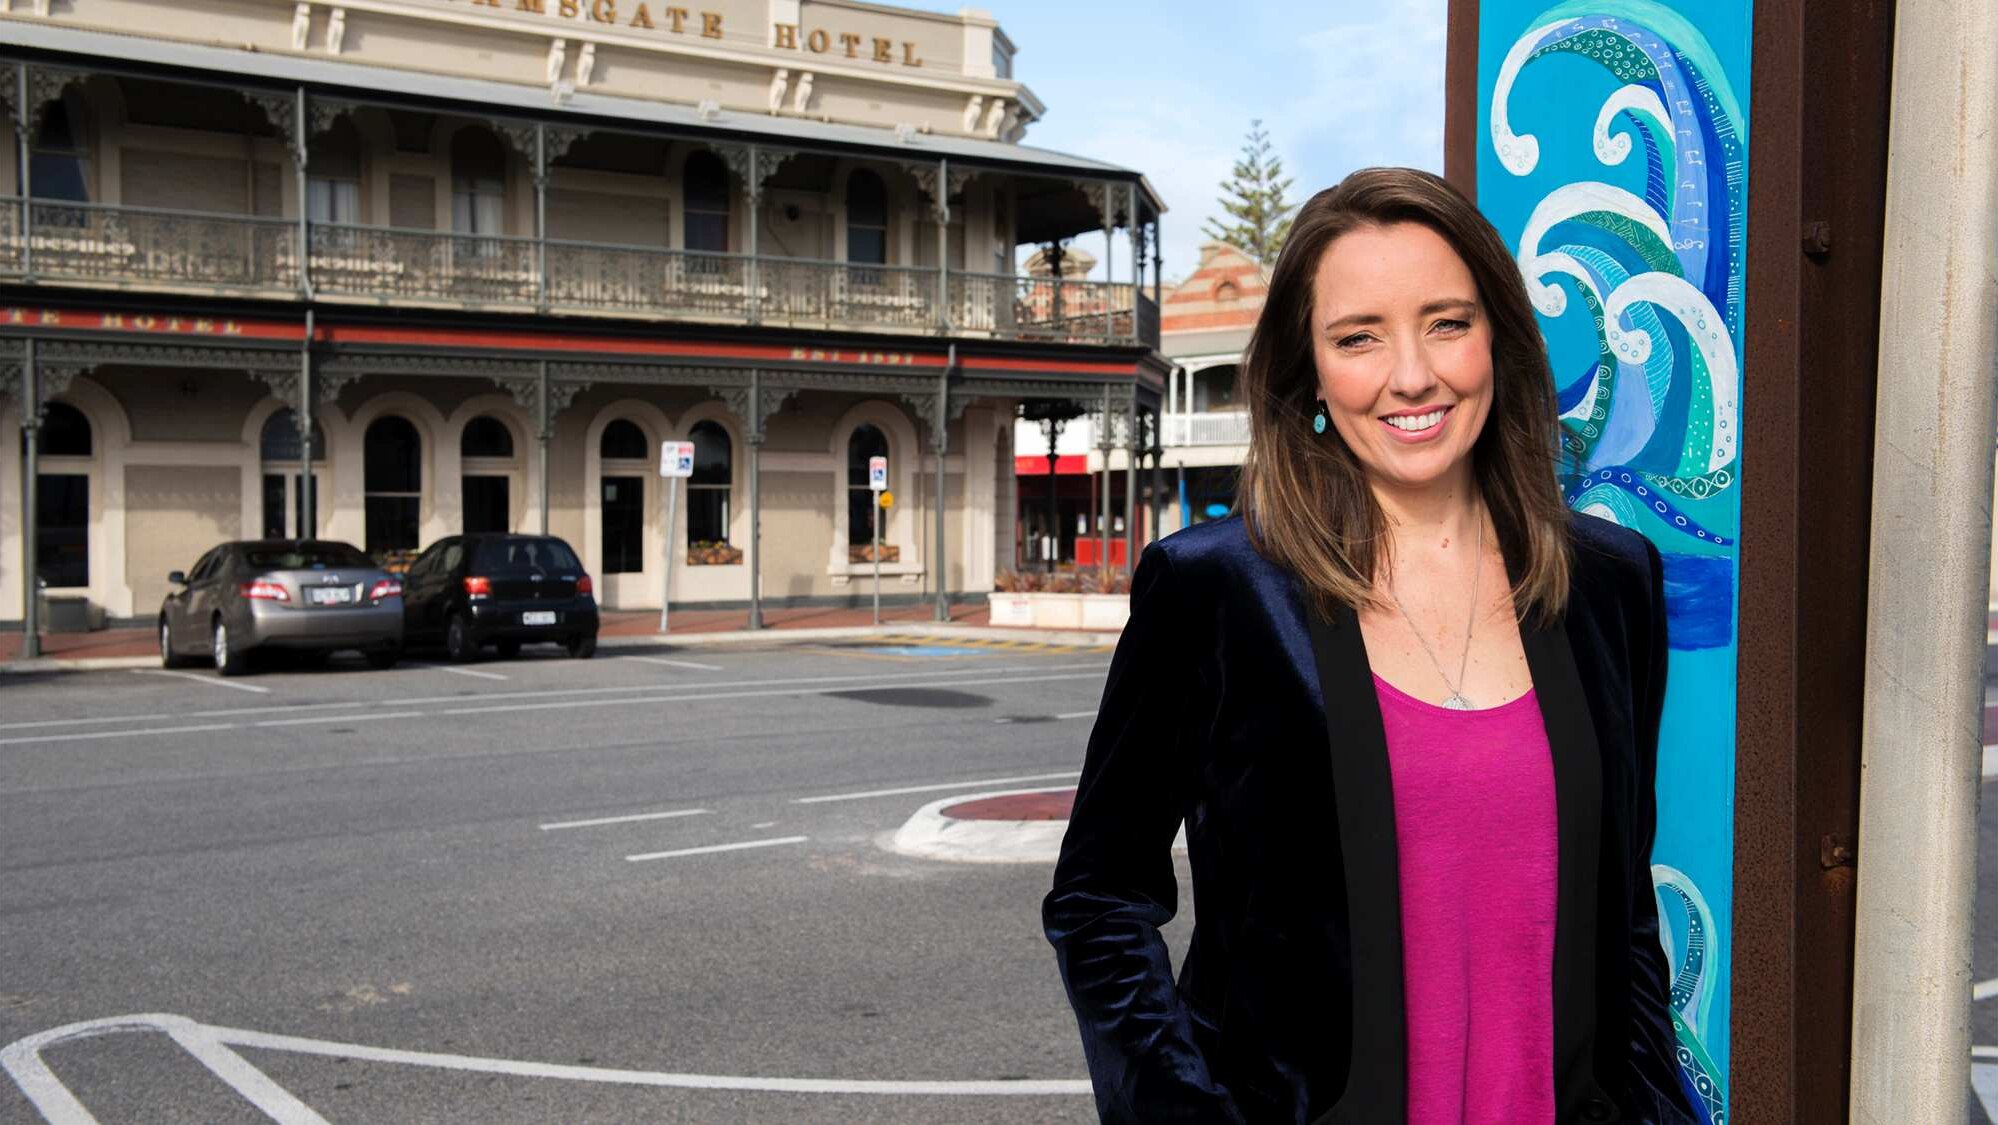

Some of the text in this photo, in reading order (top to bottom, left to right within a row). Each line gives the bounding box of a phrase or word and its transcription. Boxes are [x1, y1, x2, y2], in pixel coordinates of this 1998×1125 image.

[472, 0, 924, 67] MSGATE HOTEL
[102, 312, 242, 335] HOTEL
